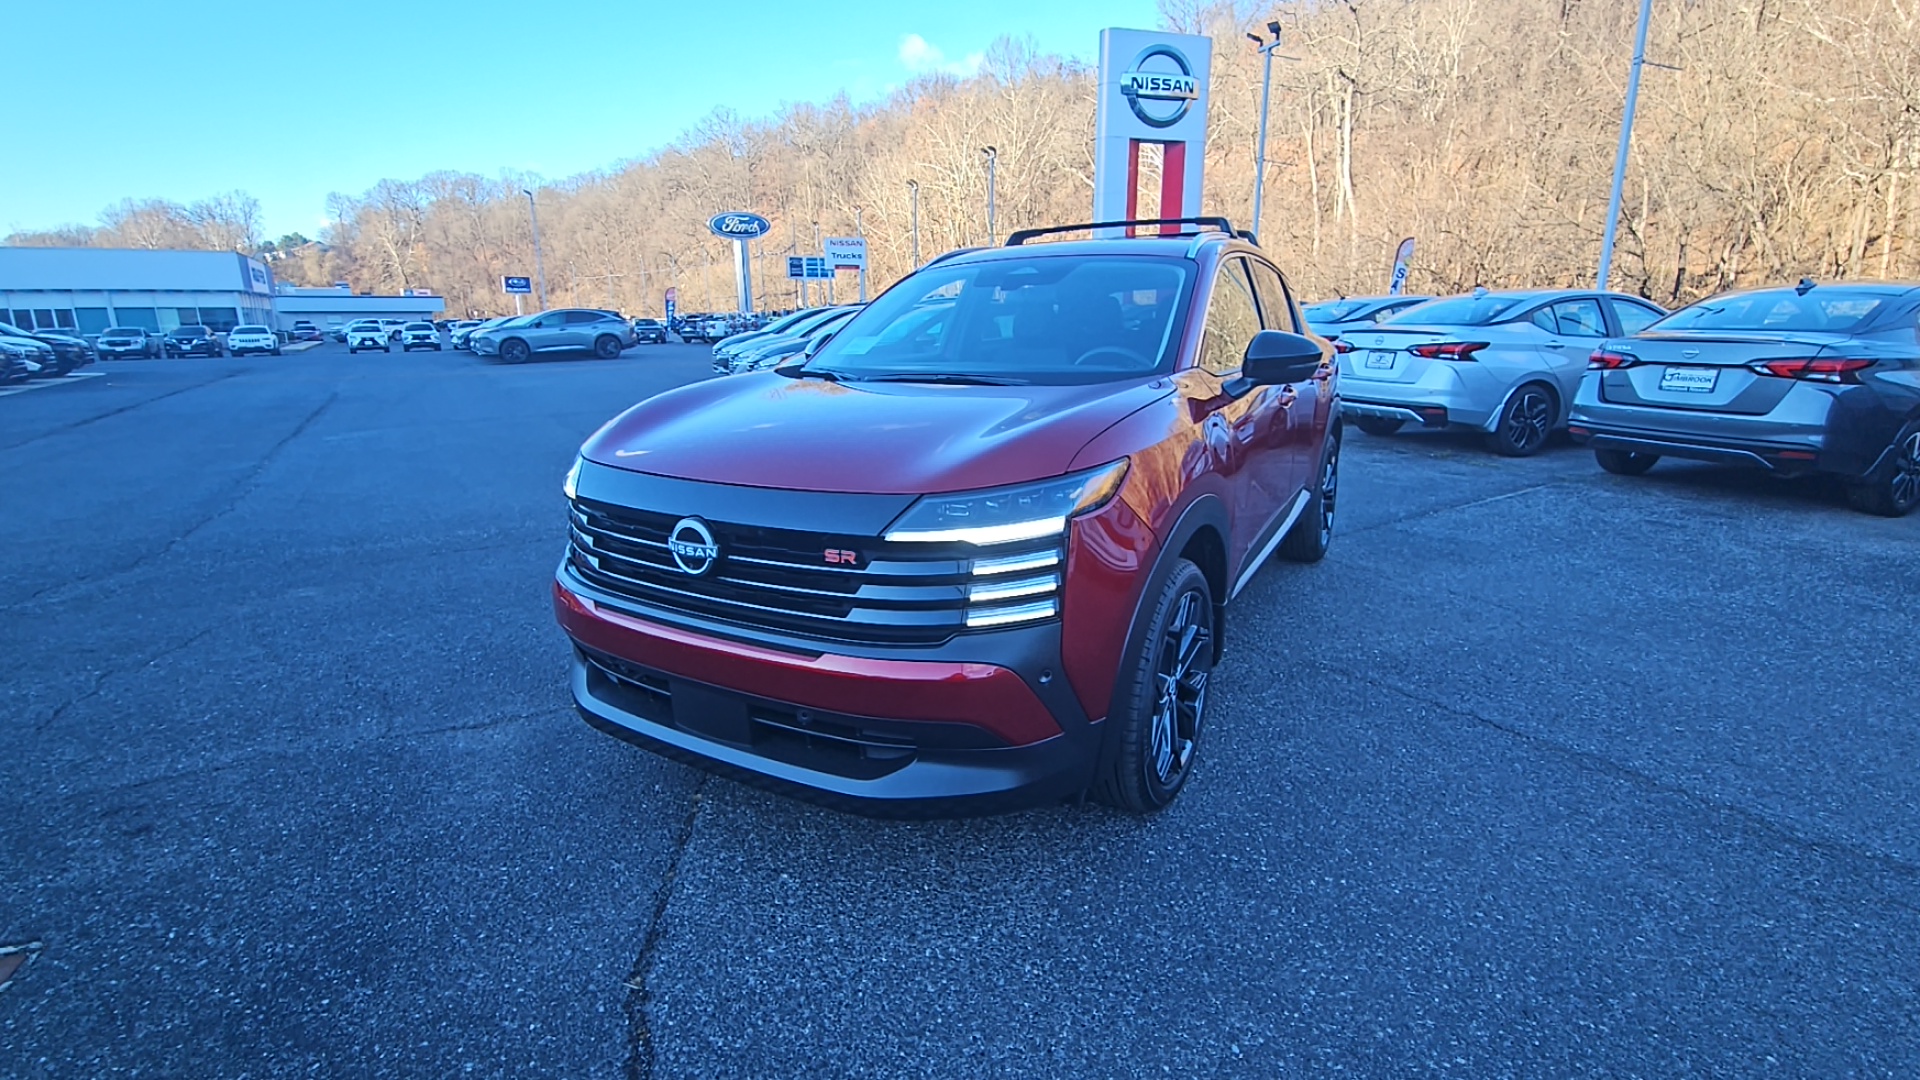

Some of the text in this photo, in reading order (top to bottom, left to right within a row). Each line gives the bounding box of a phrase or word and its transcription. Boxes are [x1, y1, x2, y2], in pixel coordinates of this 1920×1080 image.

[1131, 76, 1194, 94] NISSAN
[722, 216, 759, 232] Ford
[669, 540, 717, 558] NISSAN
[824, 548, 857, 565] SR
